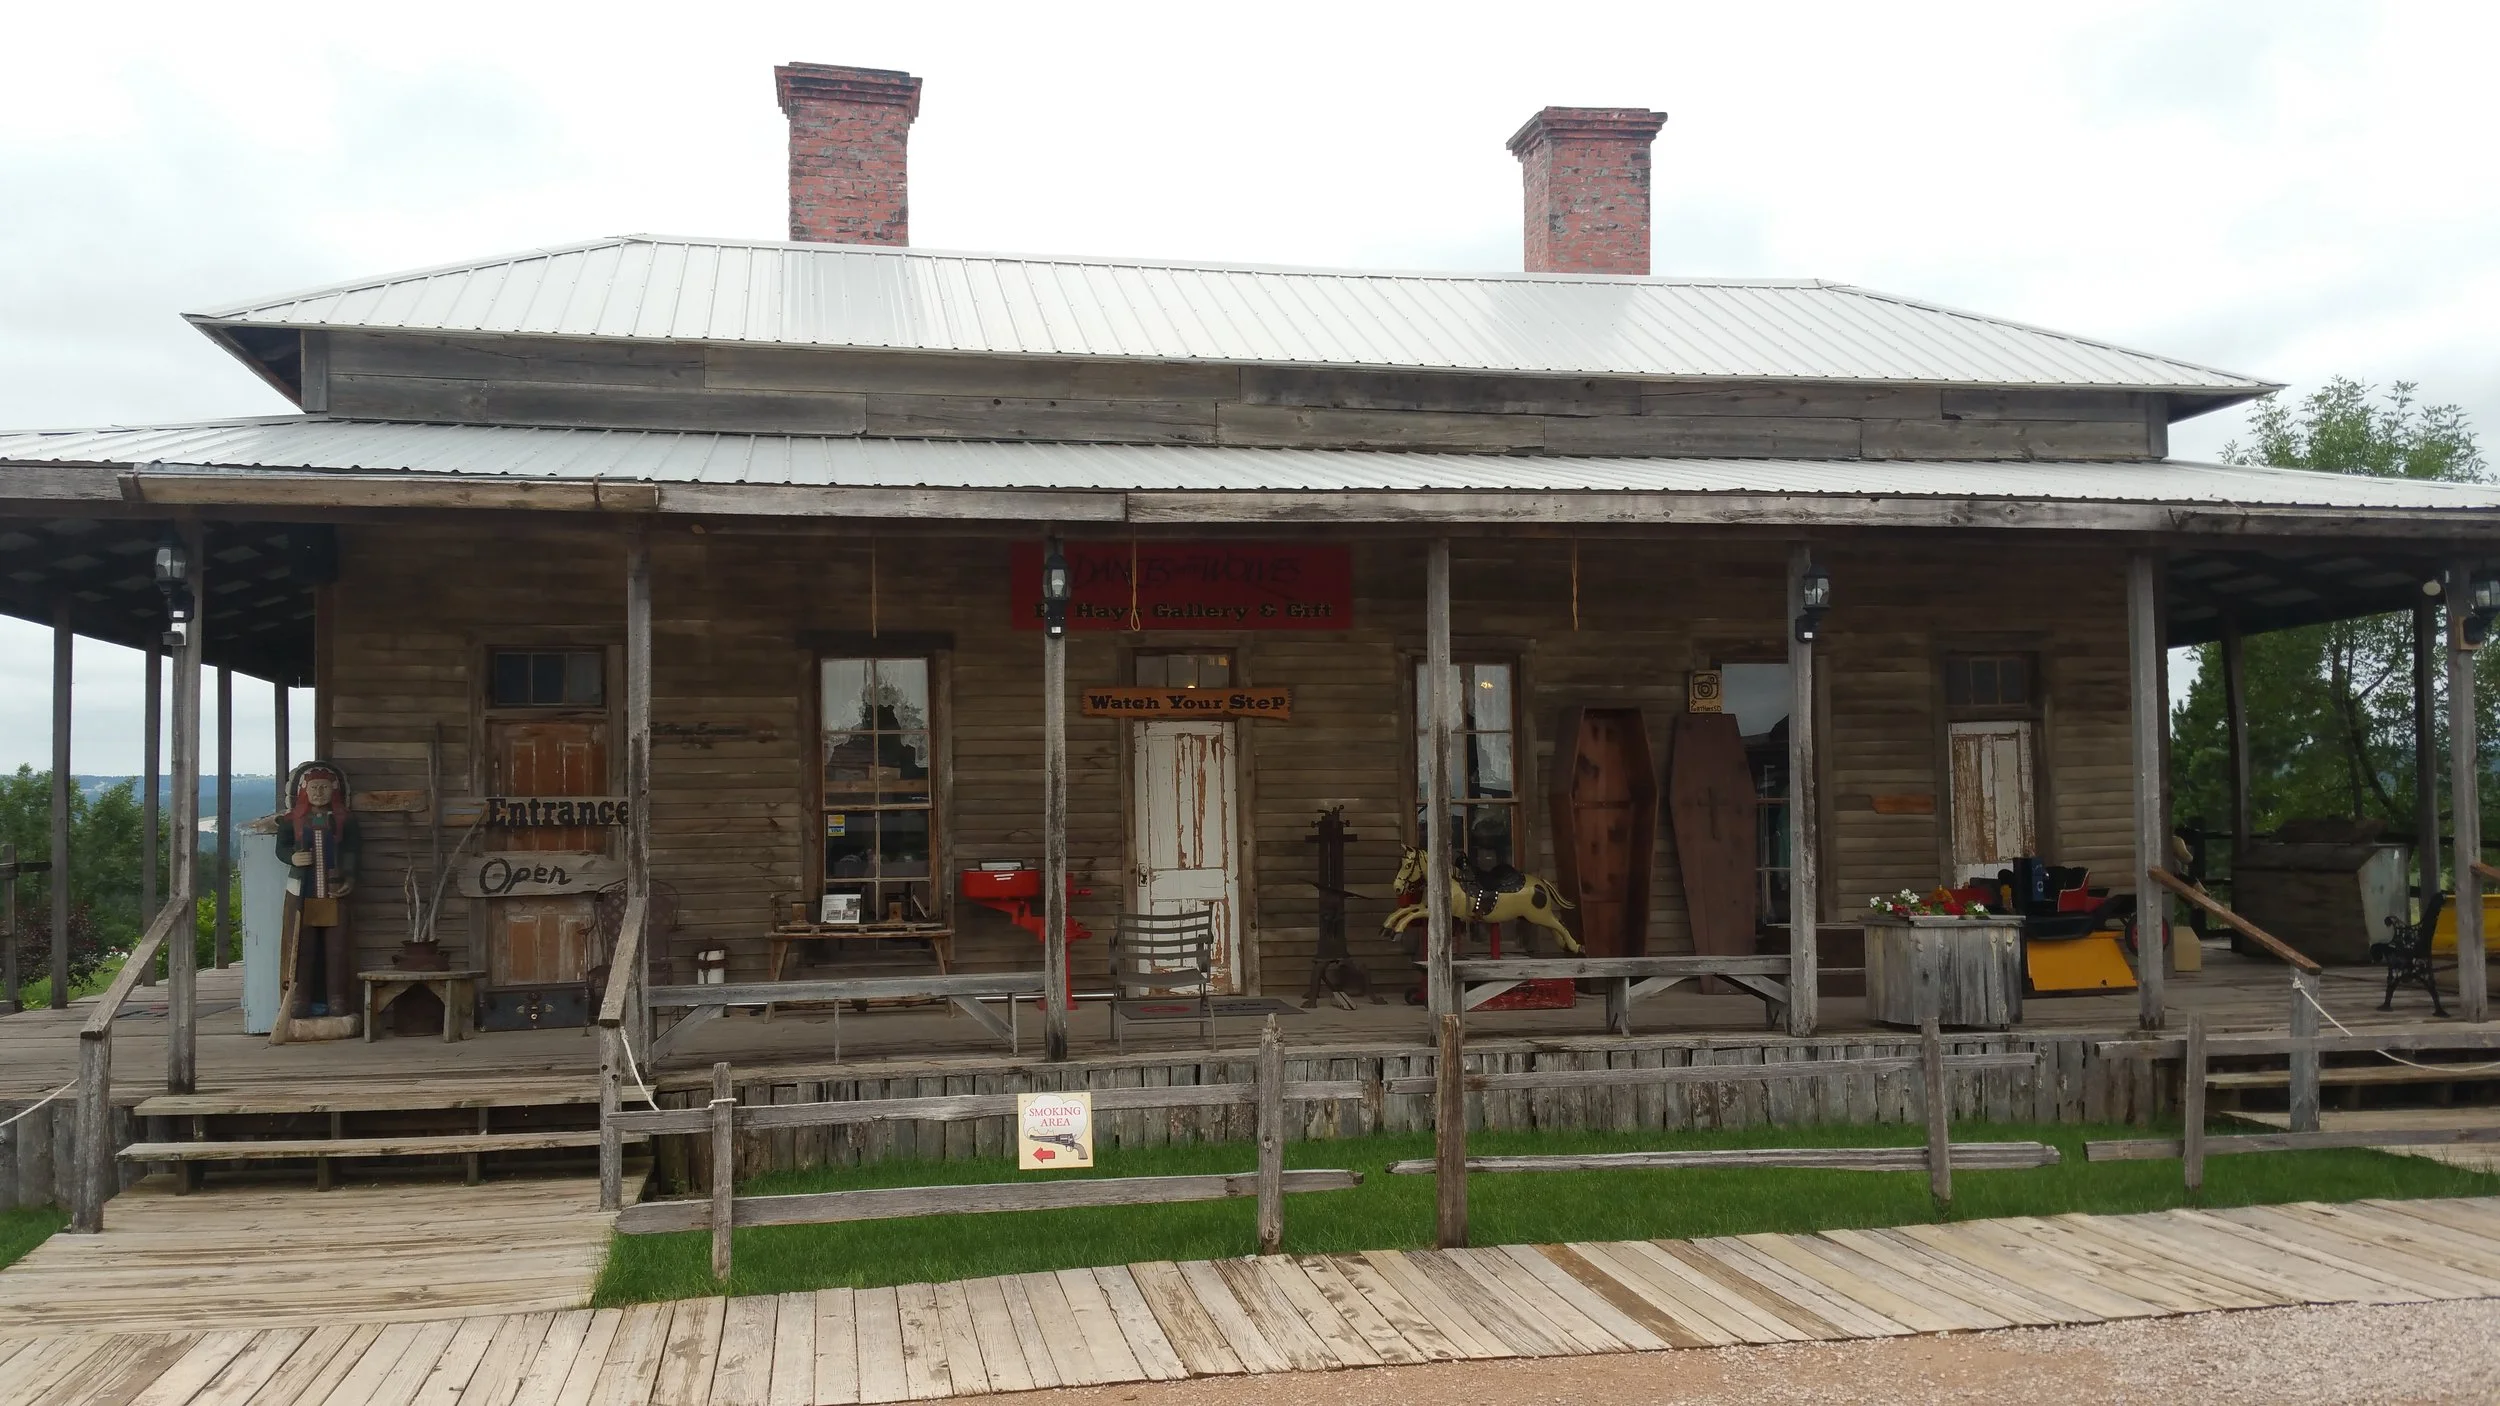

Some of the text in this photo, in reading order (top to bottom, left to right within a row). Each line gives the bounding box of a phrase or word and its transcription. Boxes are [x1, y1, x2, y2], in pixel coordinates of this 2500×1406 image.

[1153, 601, 1250, 622] Gallery
[1259, 602, 1278, 618] &
[1287, 602, 1332, 618] Gift
[1089, 694, 1161, 710] Watch
[1166, 694, 1223, 710] Your
[486, 797, 629, 828] Entrance
[479, 857, 572, 895] Open
[1029, 1106, 1081, 1117] SMOKING
[1040, 1117, 1071, 1127] AREA
